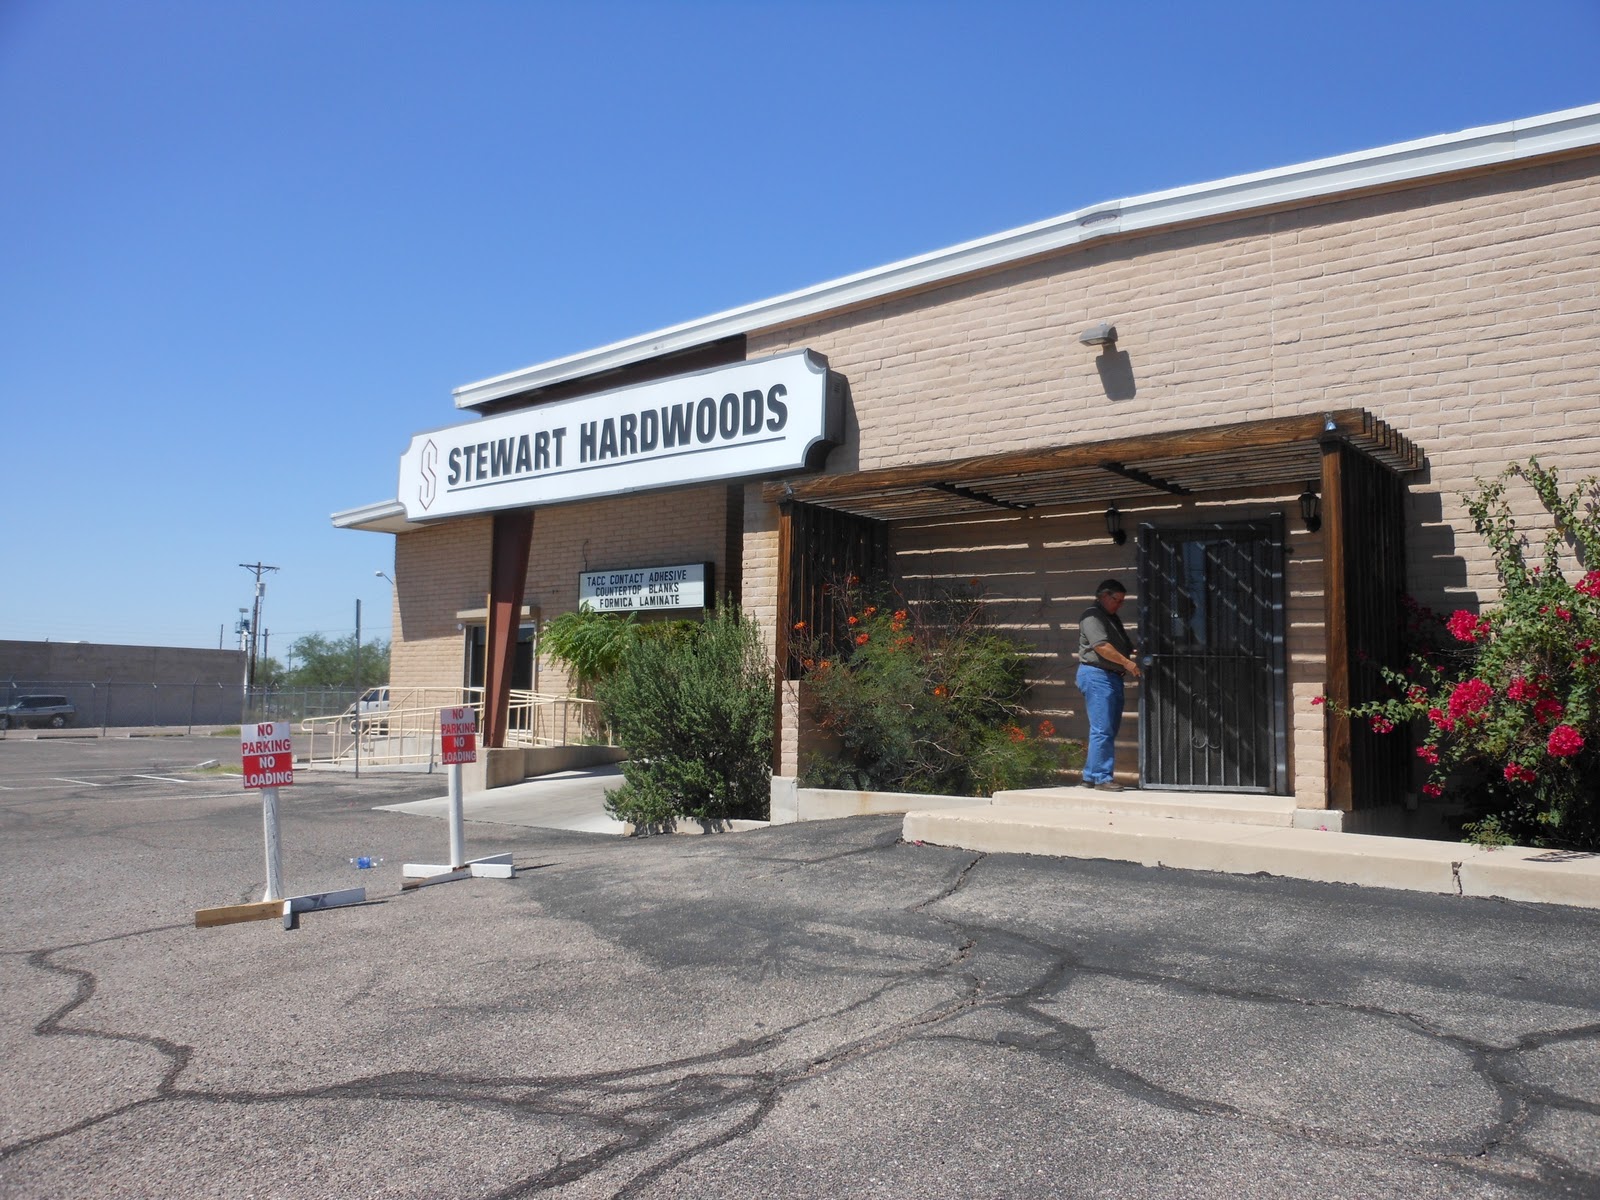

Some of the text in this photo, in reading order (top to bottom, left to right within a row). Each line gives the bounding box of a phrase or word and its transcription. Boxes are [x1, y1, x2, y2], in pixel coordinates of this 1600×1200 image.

[448, 383, 788, 486] STEWART HARDWOODS
[587, 569, 687, 587] TACC CONTACT ADHESIVE
[595, 582, 679, 597] COUNTERTOP BLANKS
[600, 594, 680, 608] FORMICA LAMINATE
[452, 709, 464, 719] NO
[257, 723, 273, 736] NO
[441, 722, 476, 734] PARKING
[242, 739, 291, 754] PARKING
[453, 736, 465, 747] NO
[259, 756, 275, 768] NO
[442, 750, 477, 763] LOADING
[244, 771, 293, 787] LOADING
